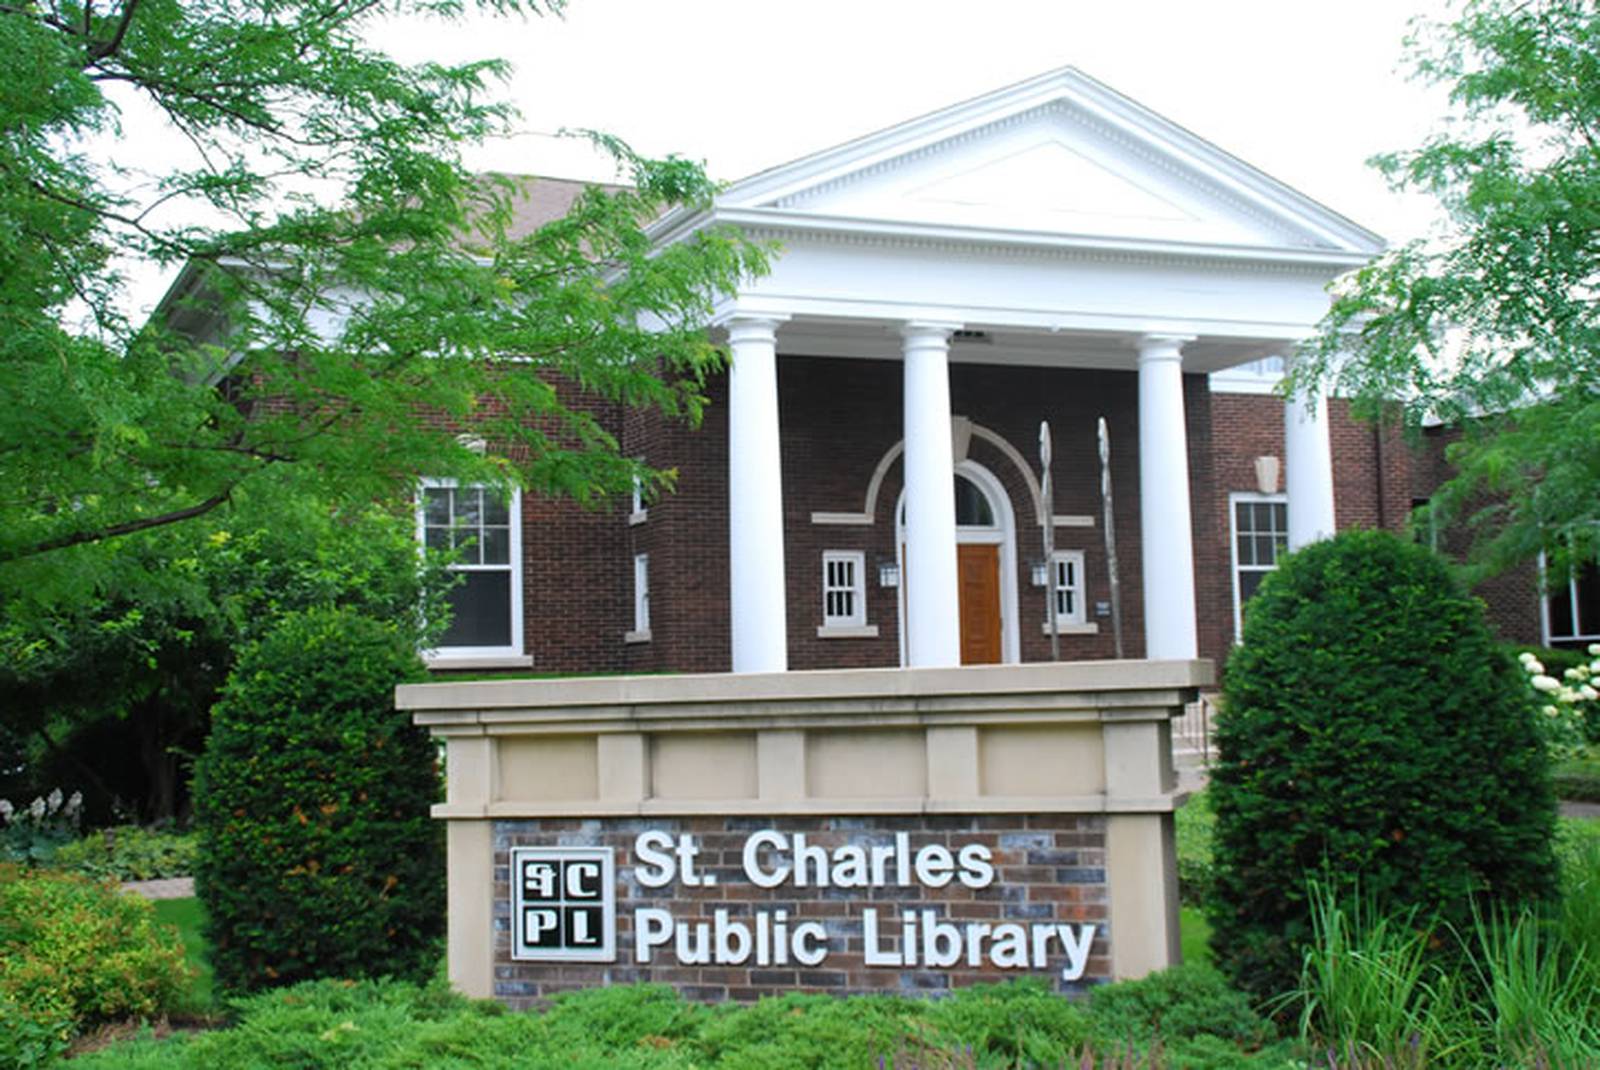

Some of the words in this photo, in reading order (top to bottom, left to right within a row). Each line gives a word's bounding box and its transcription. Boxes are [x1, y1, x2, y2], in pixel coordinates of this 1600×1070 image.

[634, 829, 717, 888] St.
[742, 829, 995, 888] Charles
[634, 907, 828, 966] Public
[862, 907, 1096, 981] Library
